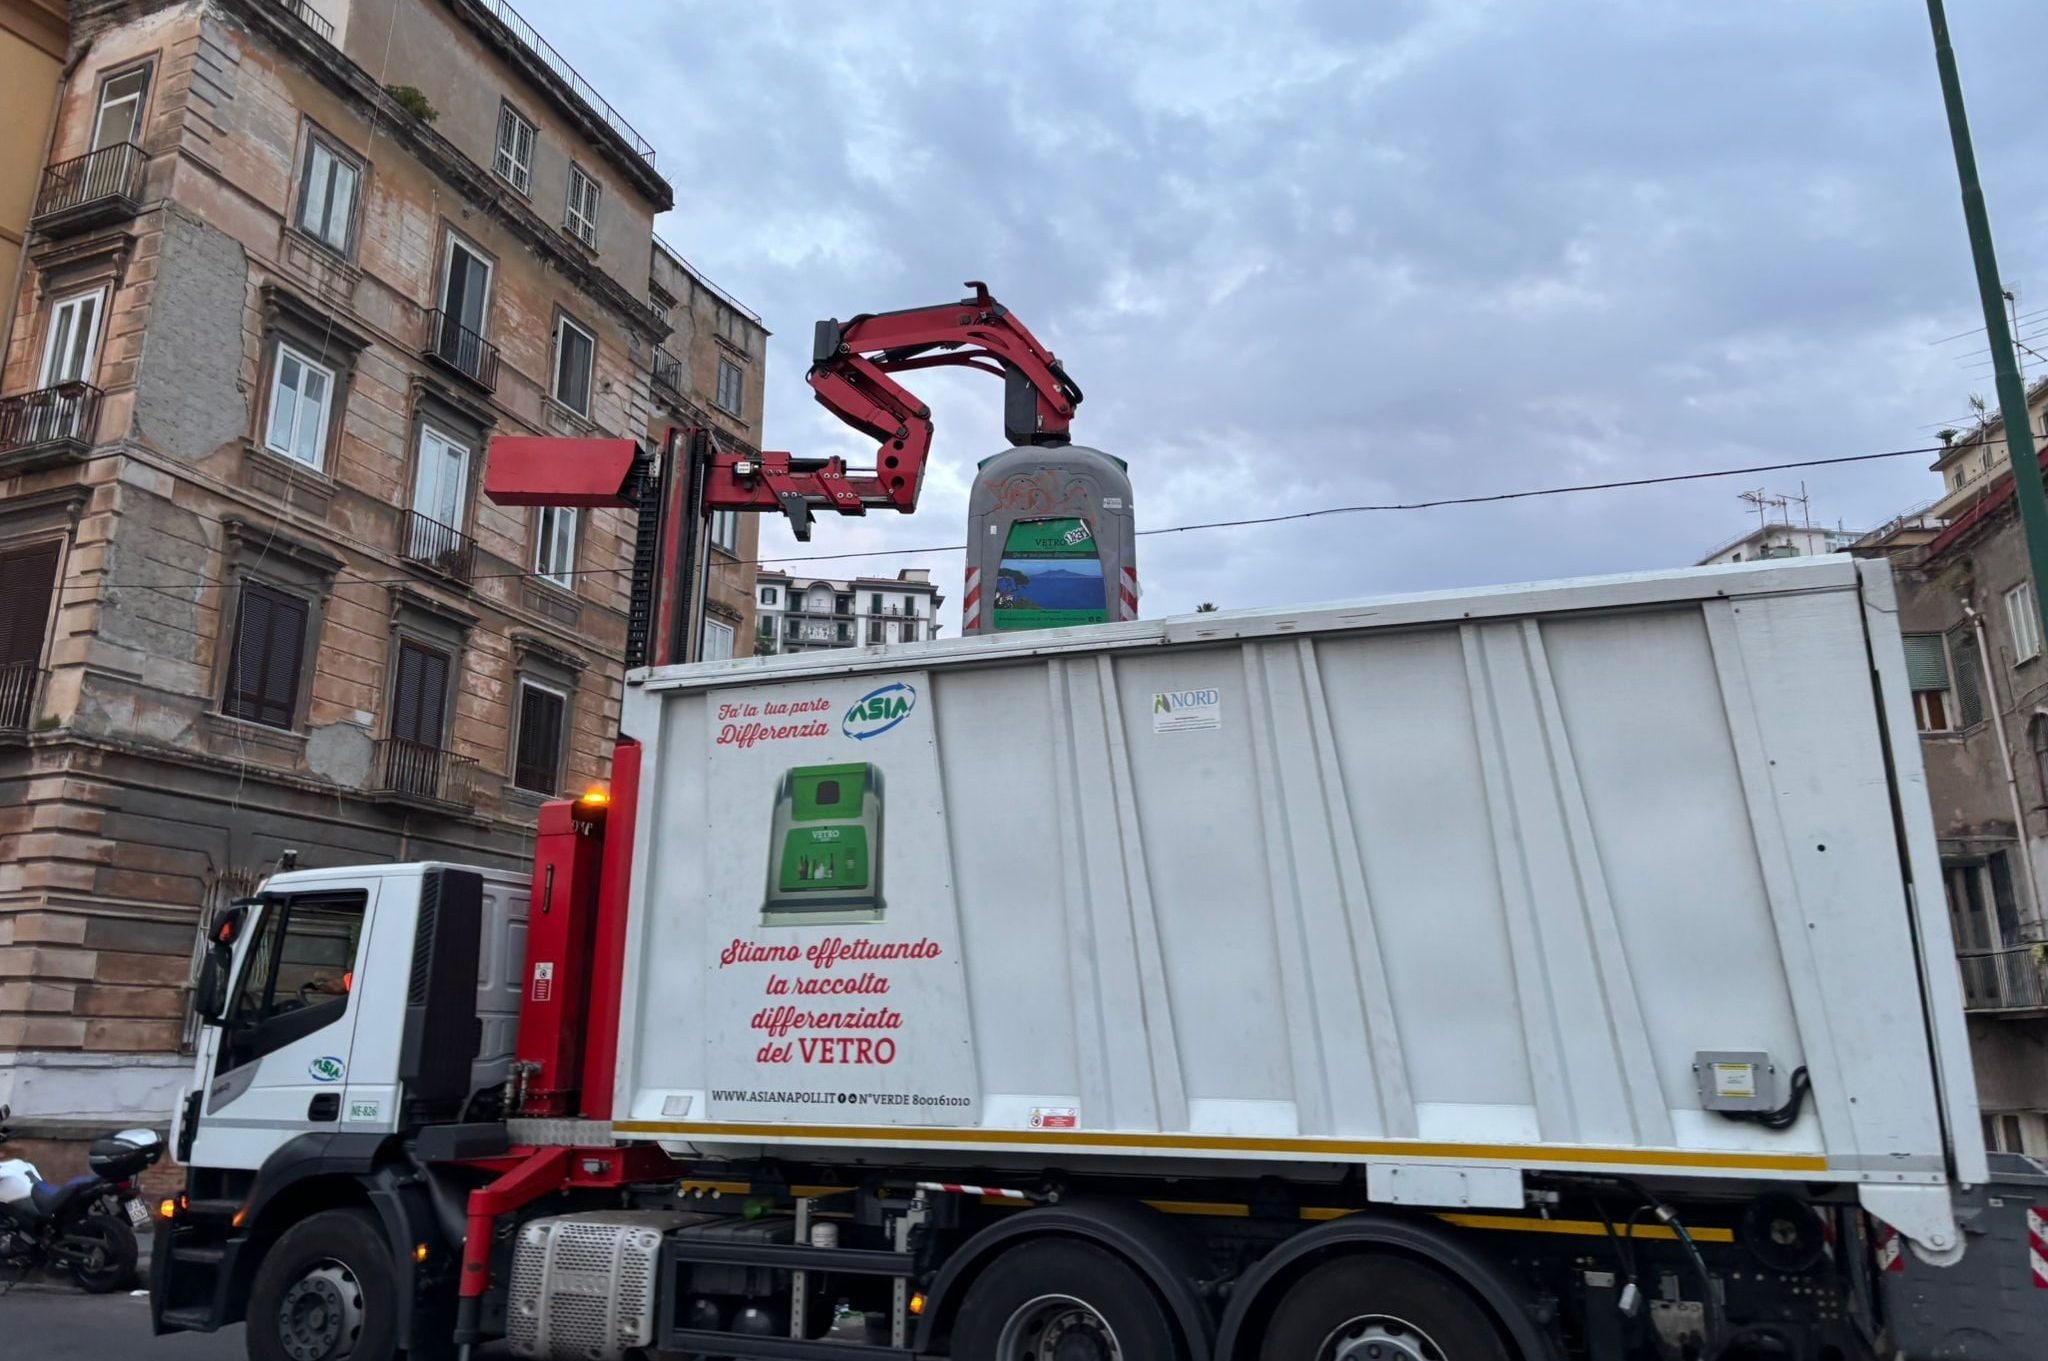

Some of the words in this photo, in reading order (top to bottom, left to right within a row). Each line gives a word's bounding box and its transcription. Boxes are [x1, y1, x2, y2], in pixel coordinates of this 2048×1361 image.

[1035, 538, 1066, 547] VETRO
[743, 703, 758, 717] la
[764, 701, 789, 716] tua
[789, 697, 831, 717] parte
[849, 696, 910, 722] ASIA
[1171, 690, 1218, 707] NORD
[716, 719, 830, 748] Differenzia
[812, 830, 840, 839] VETRO
[719, 939, 802, 969] Stiamo
[806, 937, 942, 969] effettuando
[766, 974, 790, 995] la
[792, 972, 890, 994] raccolta
[750, 1006, 903, 1037] differenziata
[756, 1042, 793, 1063] del
[798, 1037, 896, 1065] VETRO
[313, 1058, 341, 1078] ASIA
[712, 1090, 837, 1104] WWW.ASIANAPOLI.IT
[912, 1093, 971, 1107] 800161010
